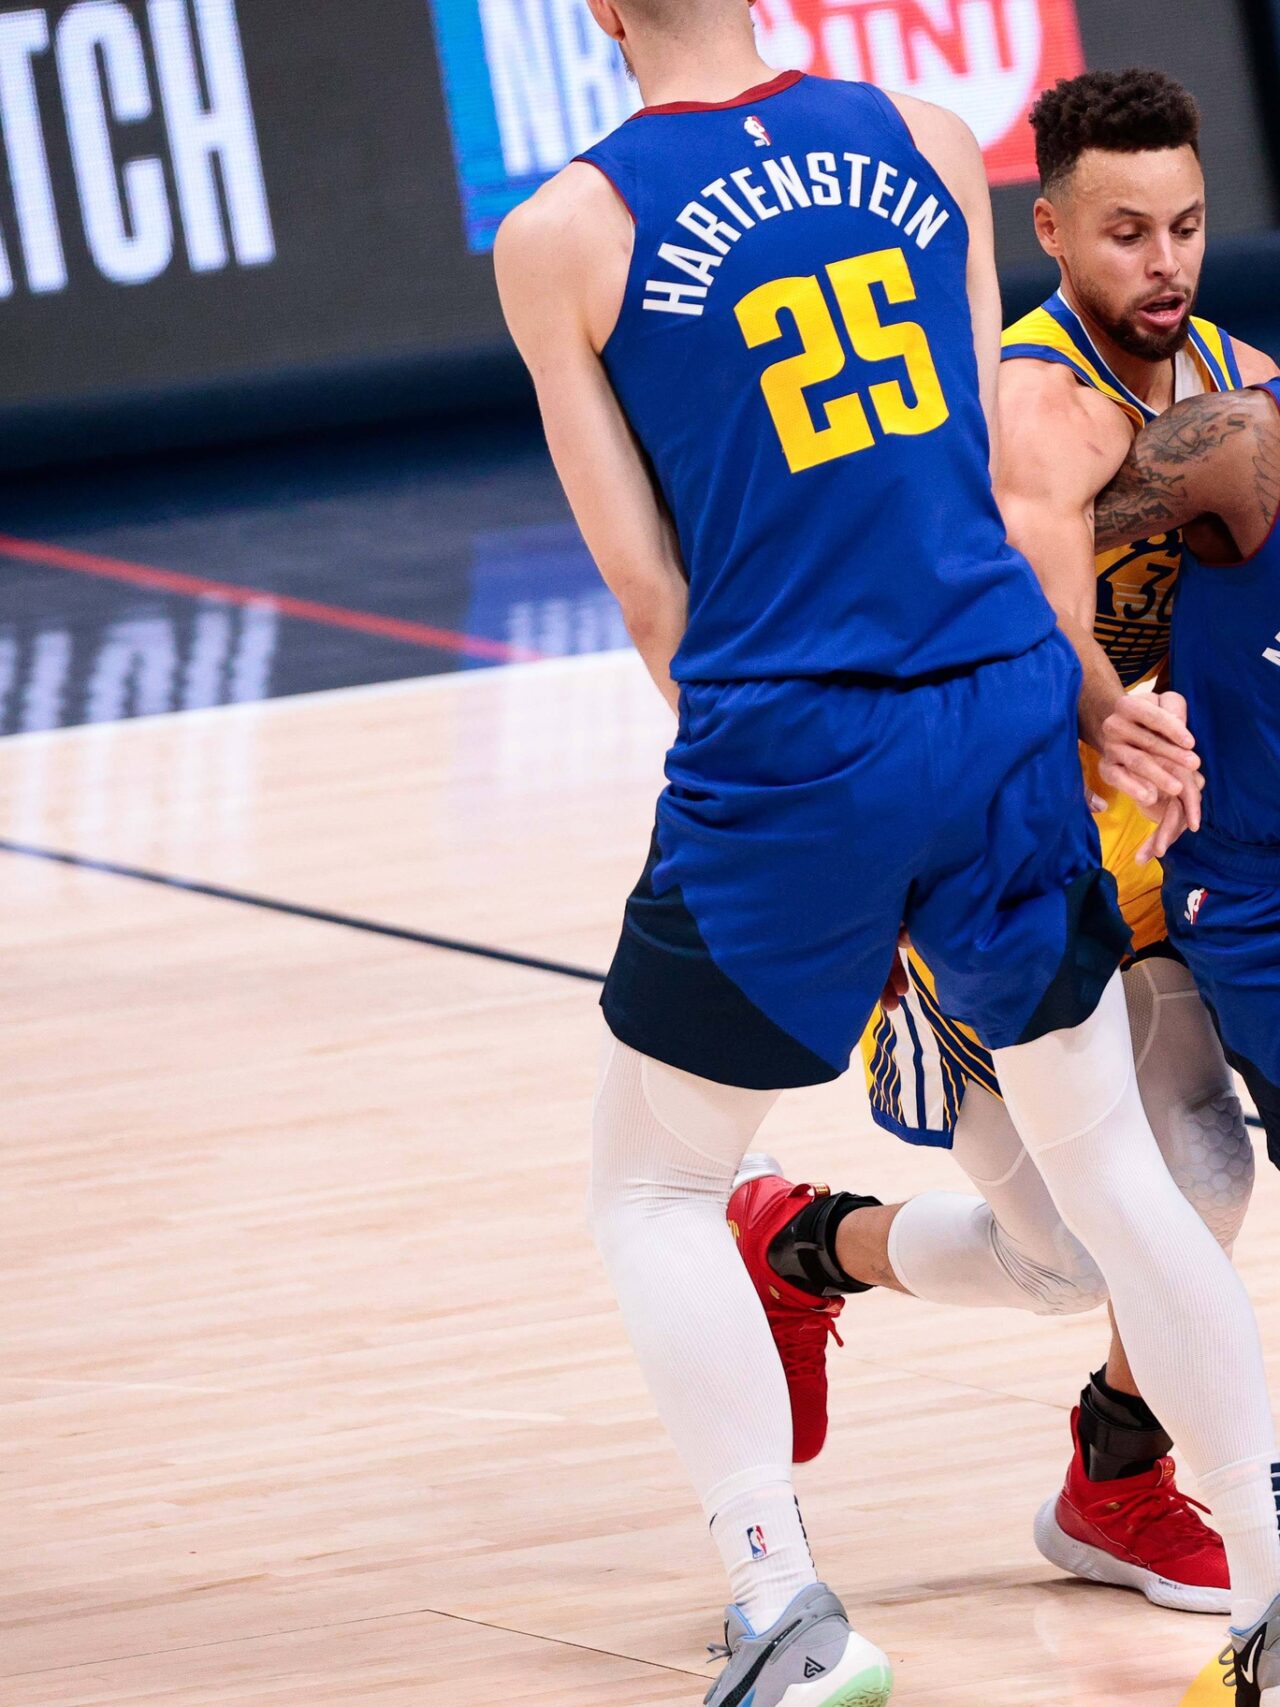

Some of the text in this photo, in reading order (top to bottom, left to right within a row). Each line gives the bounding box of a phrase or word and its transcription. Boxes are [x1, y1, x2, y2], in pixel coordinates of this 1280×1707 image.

[0, 0, 277, 298] TCH
[642, 151, 950, 316] HARTENSTEIN
[733, 247, 950, 475] 25
